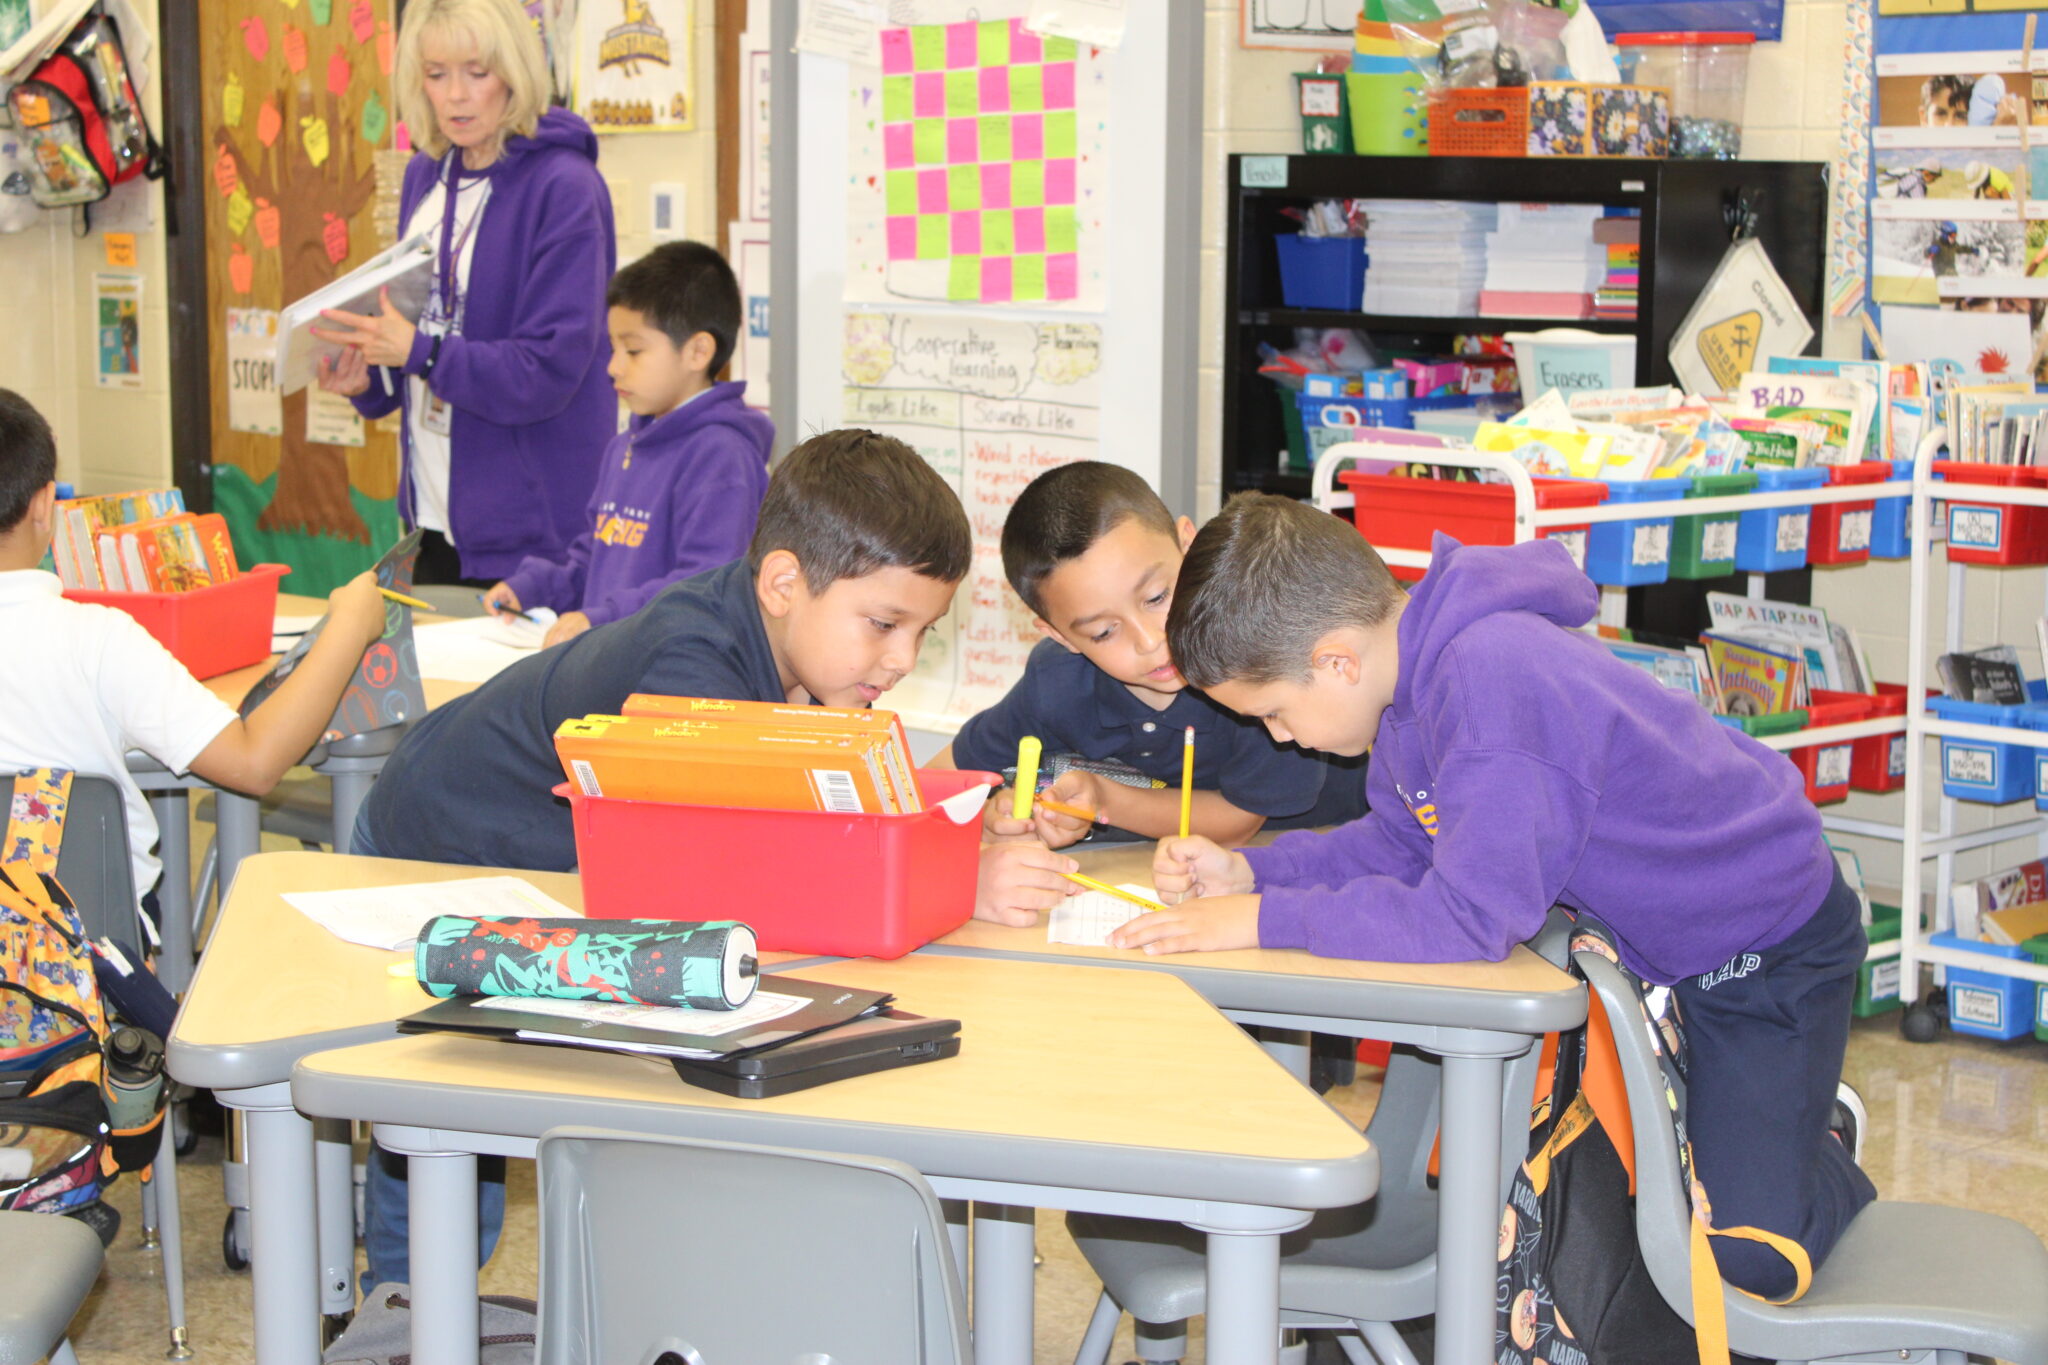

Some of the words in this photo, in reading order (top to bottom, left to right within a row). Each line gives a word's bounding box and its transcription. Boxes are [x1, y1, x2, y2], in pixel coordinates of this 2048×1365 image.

[1752, 280, 1785, 327] Closed
[900, 318, 999, 357] Cooperative
[950, 359, 1019, 393] learning
[1540, 361, 1604, 390] Erasers
[901, 394, 939, 417] Like
[1751, 386, 1805, 408] BAD
[974, 402, 1030, 428] Sounds
[1037, 407, 1075, 428] Like
[1713, 601, 1743, 619] RAP
[1747, 606, 1758, 621] A
[1760, 607, 1787, 625] TAP
[1725, 647, 1761, 668] Susan
[690, 698, 736, 712] Wonders
[653, 727, 700, 738] Wonders
